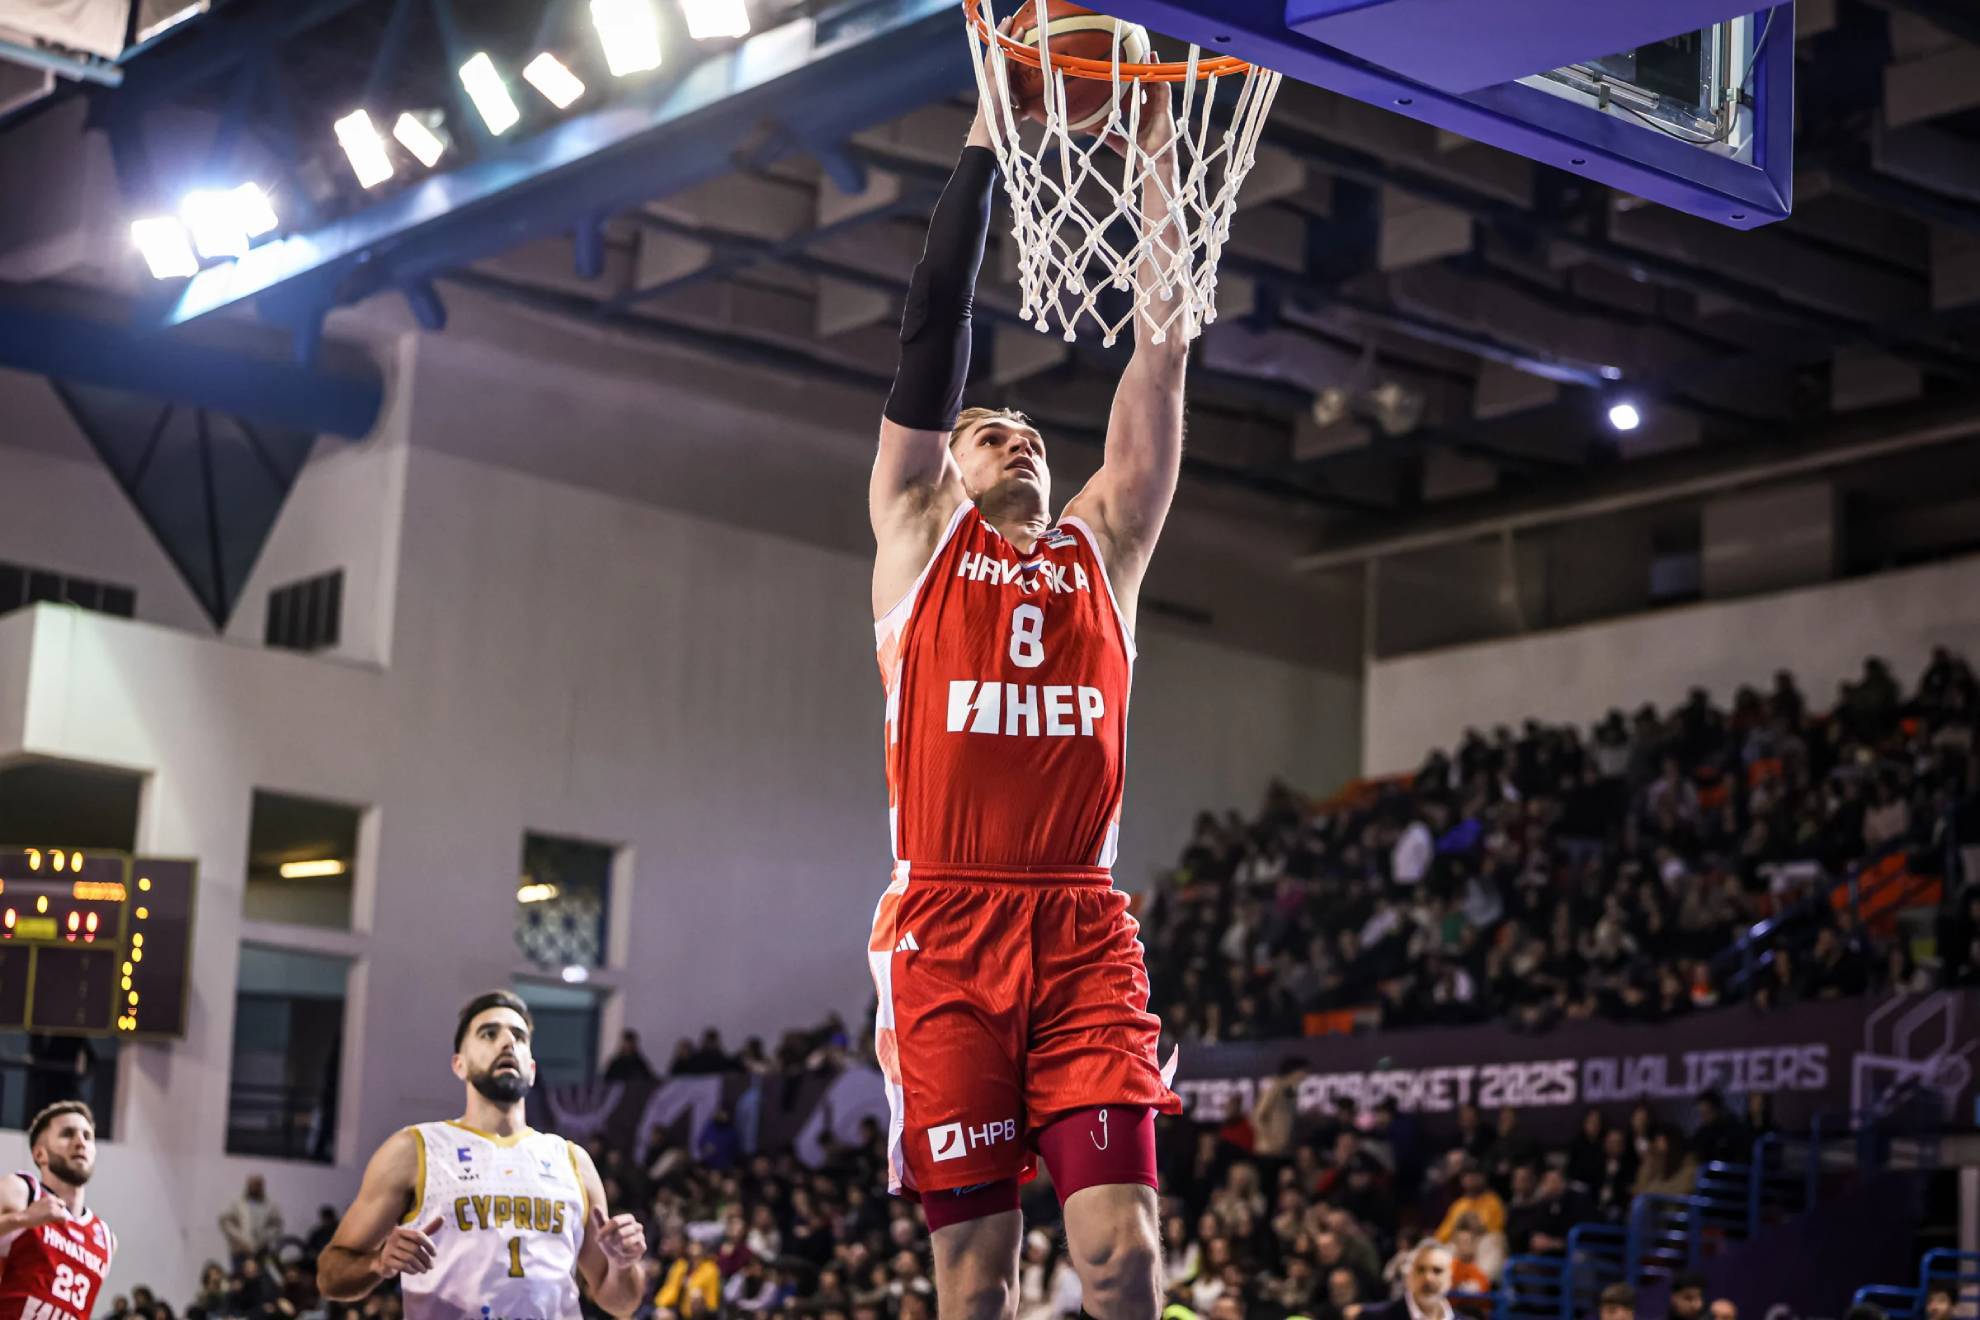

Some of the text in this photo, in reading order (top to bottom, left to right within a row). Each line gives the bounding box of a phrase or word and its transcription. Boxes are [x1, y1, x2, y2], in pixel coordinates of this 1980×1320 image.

[957, 552, 1090, 594] HRVSKA
[1009, 603, 1045, 668] 8
[1005, 682, 1105, 737] HEP
[1479, 1060, 1577, 1109] 2025
[1583, 1044, 1828, 1100] QUALIFIERS
[969, 1118, 1016, 1149] HPB
[454, 1195, 566, 1234] CYPRUS
[508, 1236, 525, 1278] 1
[51, 1263, 91, 1311] 23
